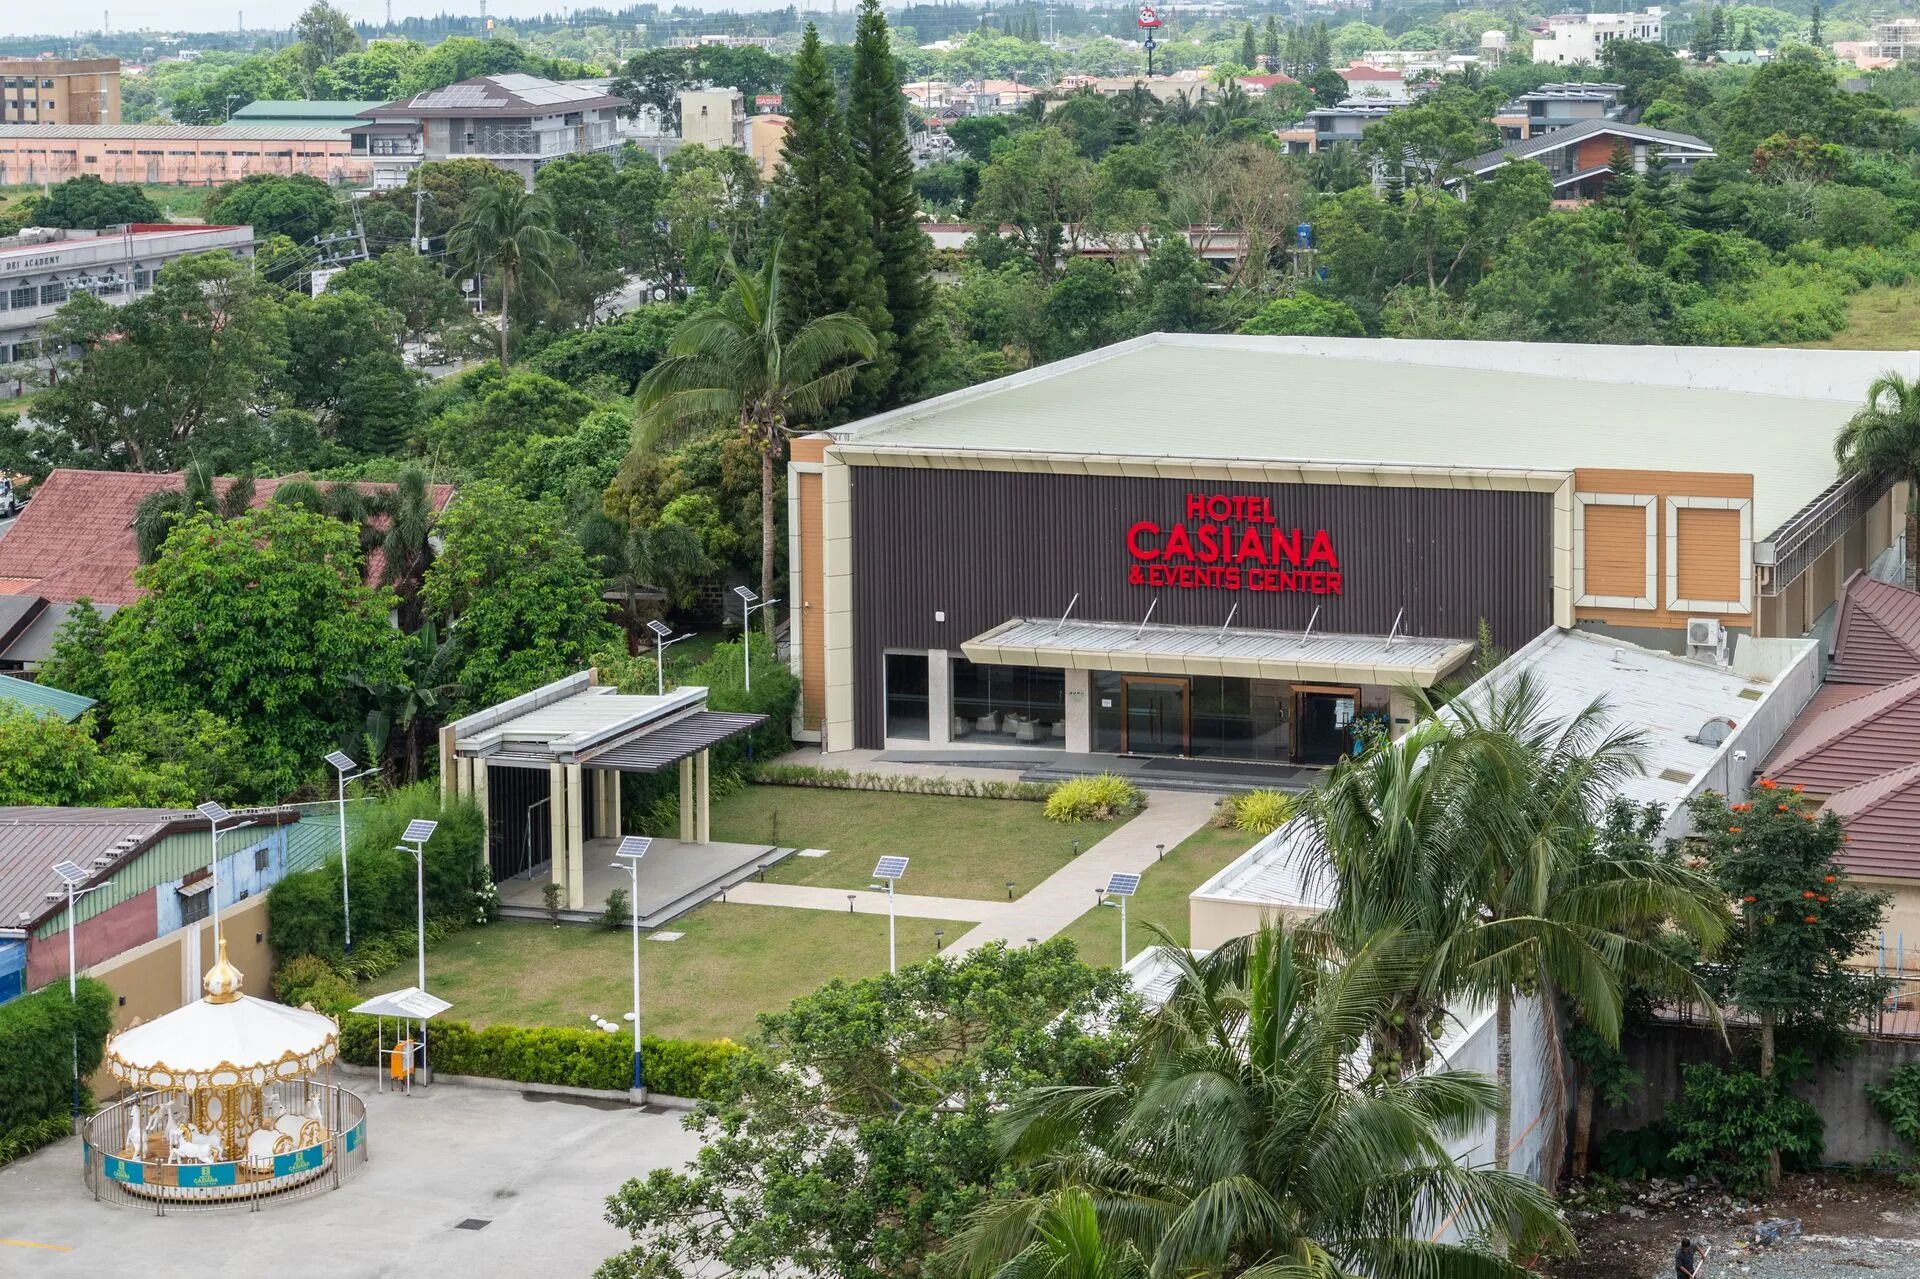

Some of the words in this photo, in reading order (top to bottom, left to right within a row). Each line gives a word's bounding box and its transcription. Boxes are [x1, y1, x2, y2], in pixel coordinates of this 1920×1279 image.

[6, 261, 20, 270] DEI
[24, 256, 60, 267] ACADEMY
[1186, 493, 1276, 524] HOTEL
[1126, 520, 1339, 568] CASIANA
[1128, 564, 1144, 586] &
[1149, 565, 1241, 590] EVENTS
[1248, 568, 1342, 595] CENTER
